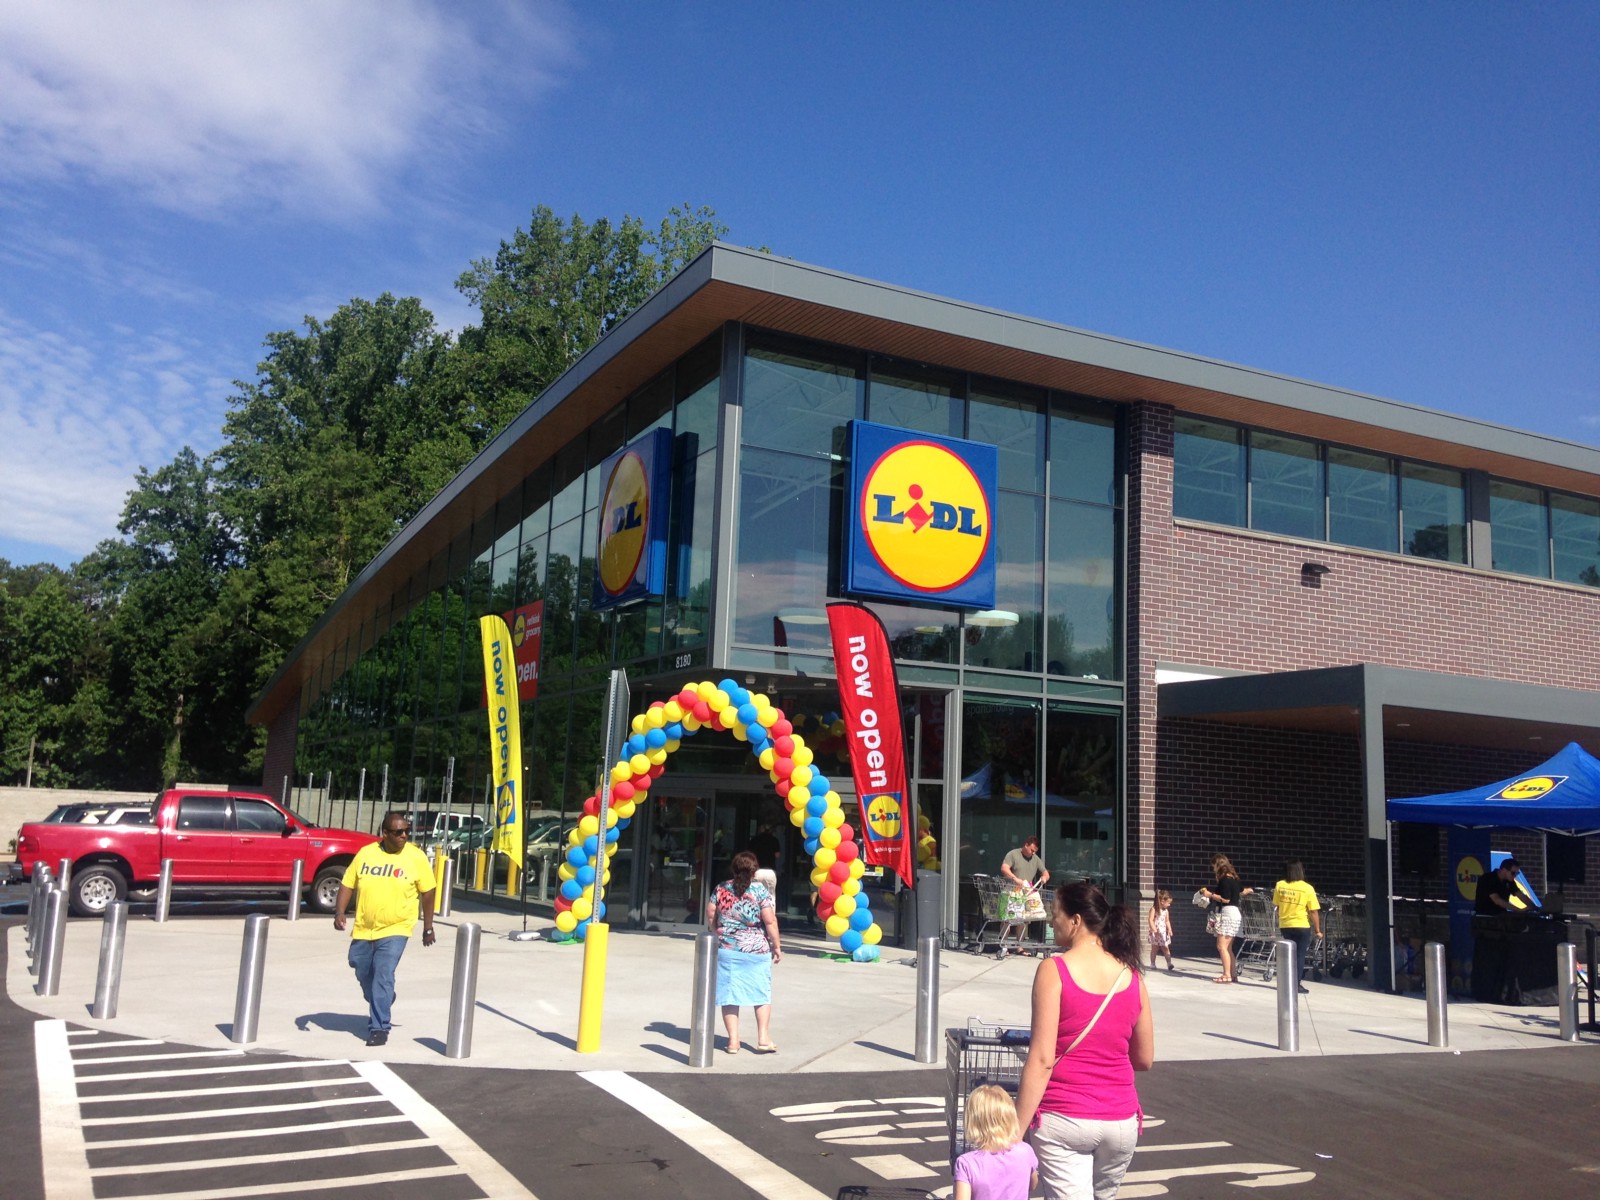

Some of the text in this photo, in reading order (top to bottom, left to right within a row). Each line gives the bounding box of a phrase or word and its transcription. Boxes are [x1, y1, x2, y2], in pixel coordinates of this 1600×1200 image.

[517, 660, 539, 684] pen.
[675, 653, 692, 669] 8180
[492, 640, 509, 778] now open
[848, 635, 888, 788] now open
